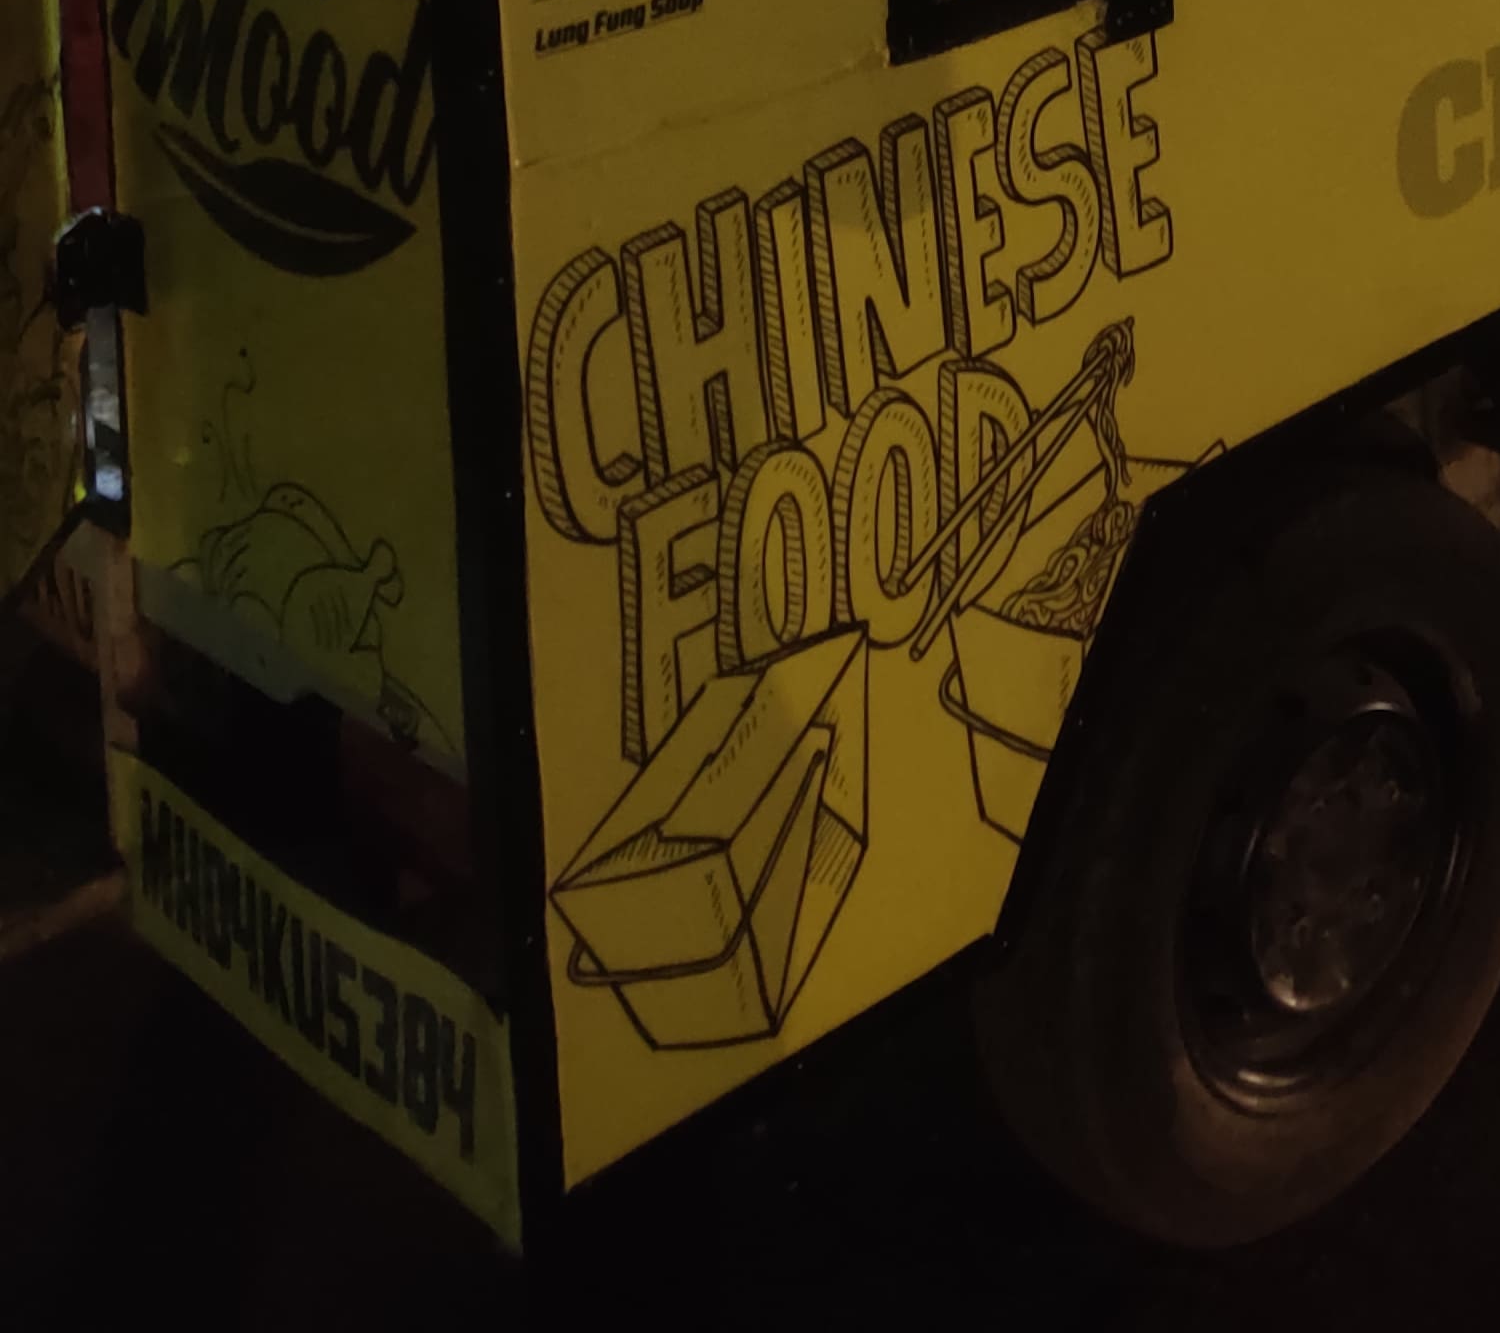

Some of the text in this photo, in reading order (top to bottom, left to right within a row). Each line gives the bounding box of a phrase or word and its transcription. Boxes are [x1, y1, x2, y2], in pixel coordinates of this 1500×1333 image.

[535, 19, 589, 52] Lung
[594, 1, 645, 31] Fung
[527, 27, 1174, 545] CHINESE
[618, 357, 1040, 765] FOOD
